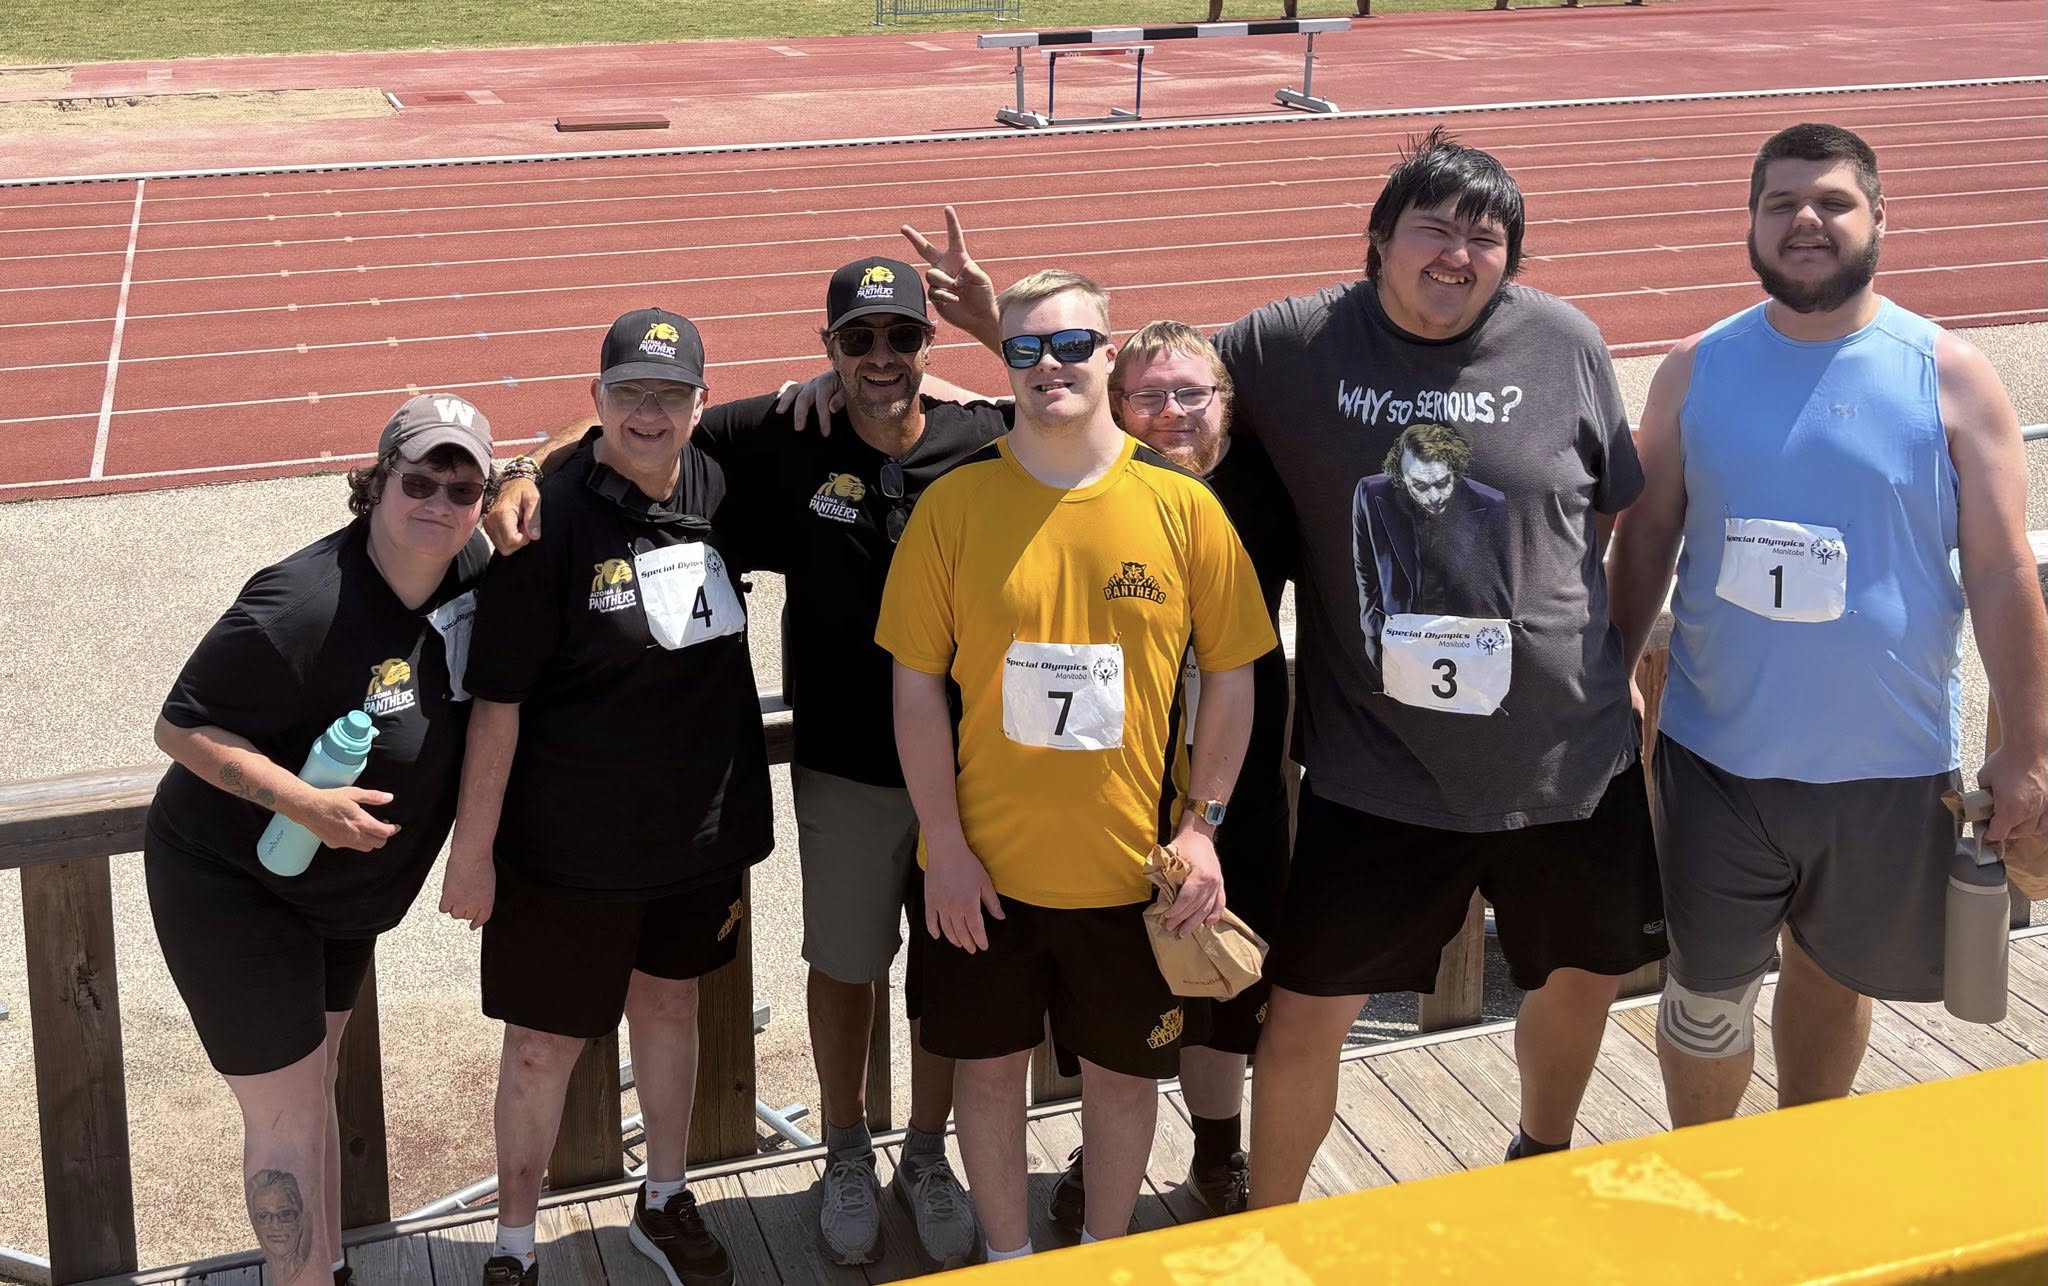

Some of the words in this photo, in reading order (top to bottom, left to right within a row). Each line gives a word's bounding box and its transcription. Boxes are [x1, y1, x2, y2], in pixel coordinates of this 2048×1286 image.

[638, 343, 677, 355] PANTHERS
[1337, 379, 1392, 426] WHY
[1387, 400, 1413, 425] SO
[433, 399, 476, 430] W
[813, 494, 838, 505] ALTONA
[809, 499, 860, 519] PANTHERS
[1726, 534, 1755, 544] Special
[1758, 537, 1805, 547] Olympics
[1772, 548, 1805, 557] Manitoba
[641, 563, 675, 579] Special
[590, 588, 614, 598] ALTONA
[1103, 584, 1166, 604] PANTHERS
[1769, 565, 1783, 609] 1
[589, 589, 636, 610] PANTHERS
[691, 585, 713, 628] 4
[1385, 627, 1422, 638] Special
[1424, 631, 1471, 640] Olympics
[1438, 640, 1471, 648] Manitoba
[1006, 656, 1038, 669] Special
[1041, 661, 1088, 672] Olympics
[1055, 672, 1088, 680] Manitoba
[1431, 658, 1458, 700] 3
[363, 688, 415, 714] PANTHERS
[364, 689, 392, 702] ALTONA
[1047, 690, 1074, 737] 7
